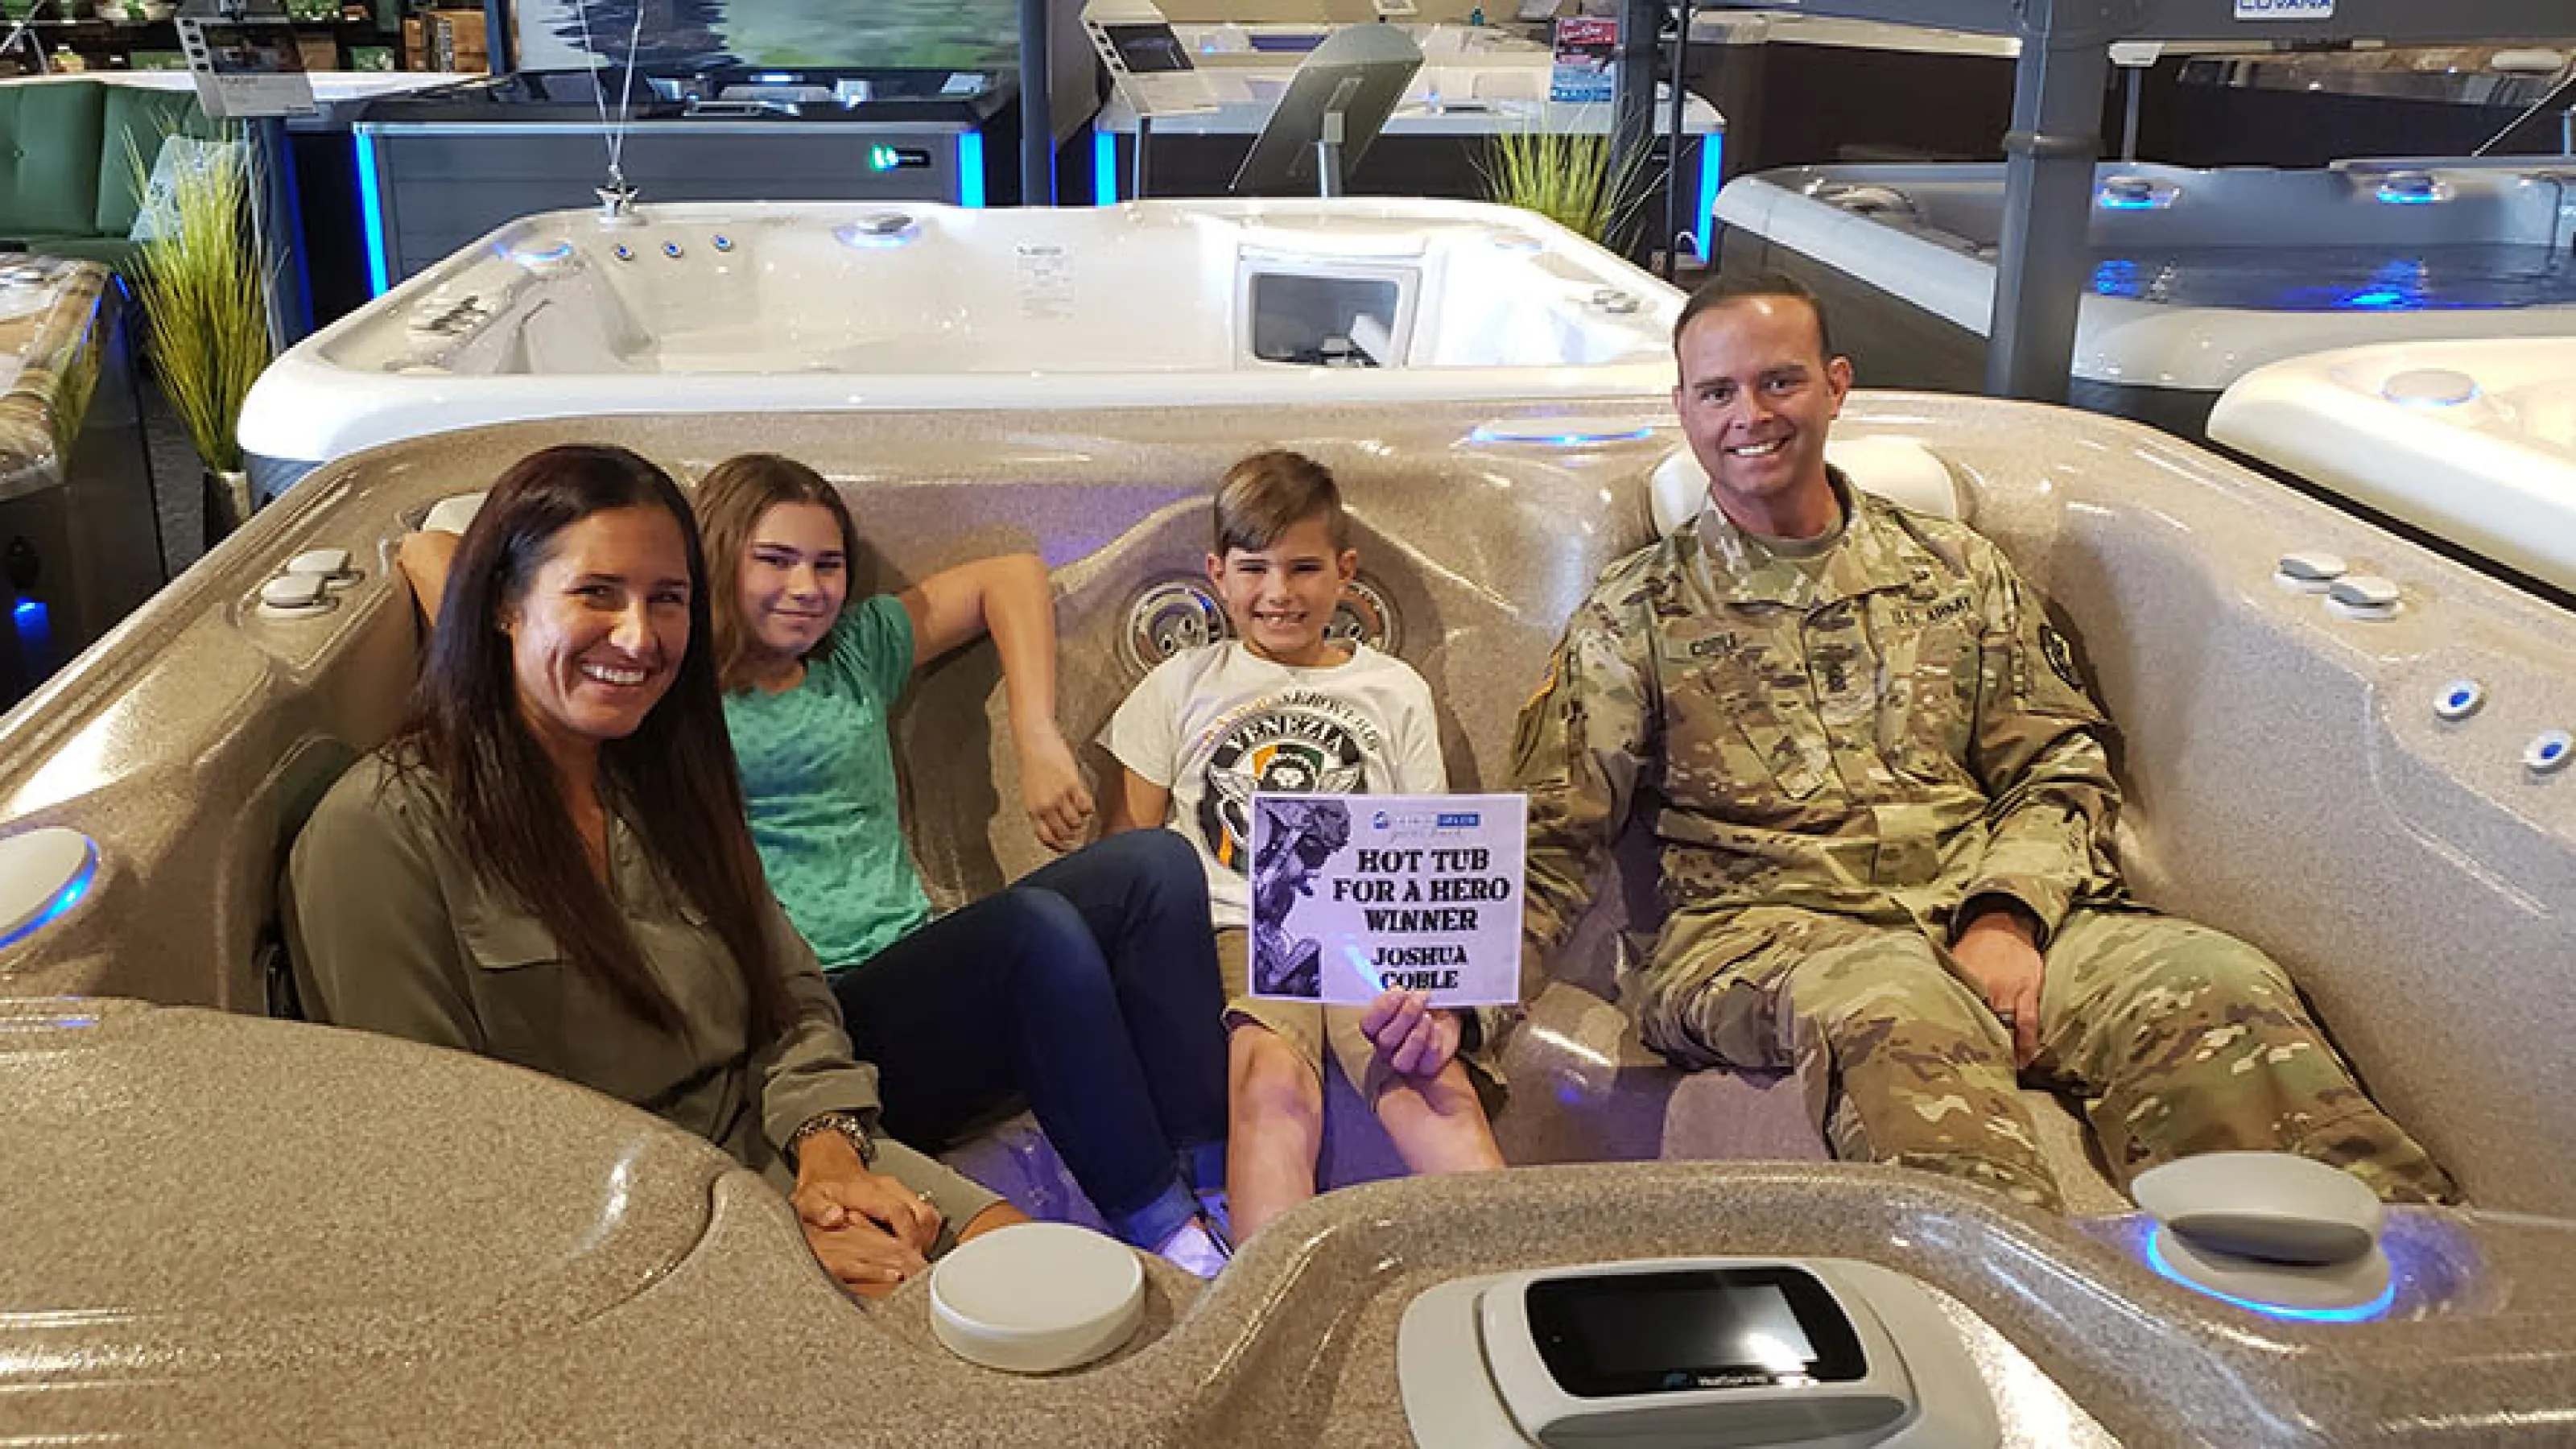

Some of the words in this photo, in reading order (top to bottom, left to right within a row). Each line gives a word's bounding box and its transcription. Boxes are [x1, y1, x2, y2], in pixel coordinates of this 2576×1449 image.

[1224, 715, 1344, 752] VENEZIA
[1358, 849, 1423, 873] HOT
[1430, 848, 1489, 872] TUB
[1333, 878, 1394, 902] FOR
[1402, 878, 1422, 902] A
[1429, 877, 1511, 902] HERO
[1364, 909, 1478, 931] WINNER
[1371, 945, 1468, 966] JOSHUA
[1380, 970, 1459, 989] COBLE
